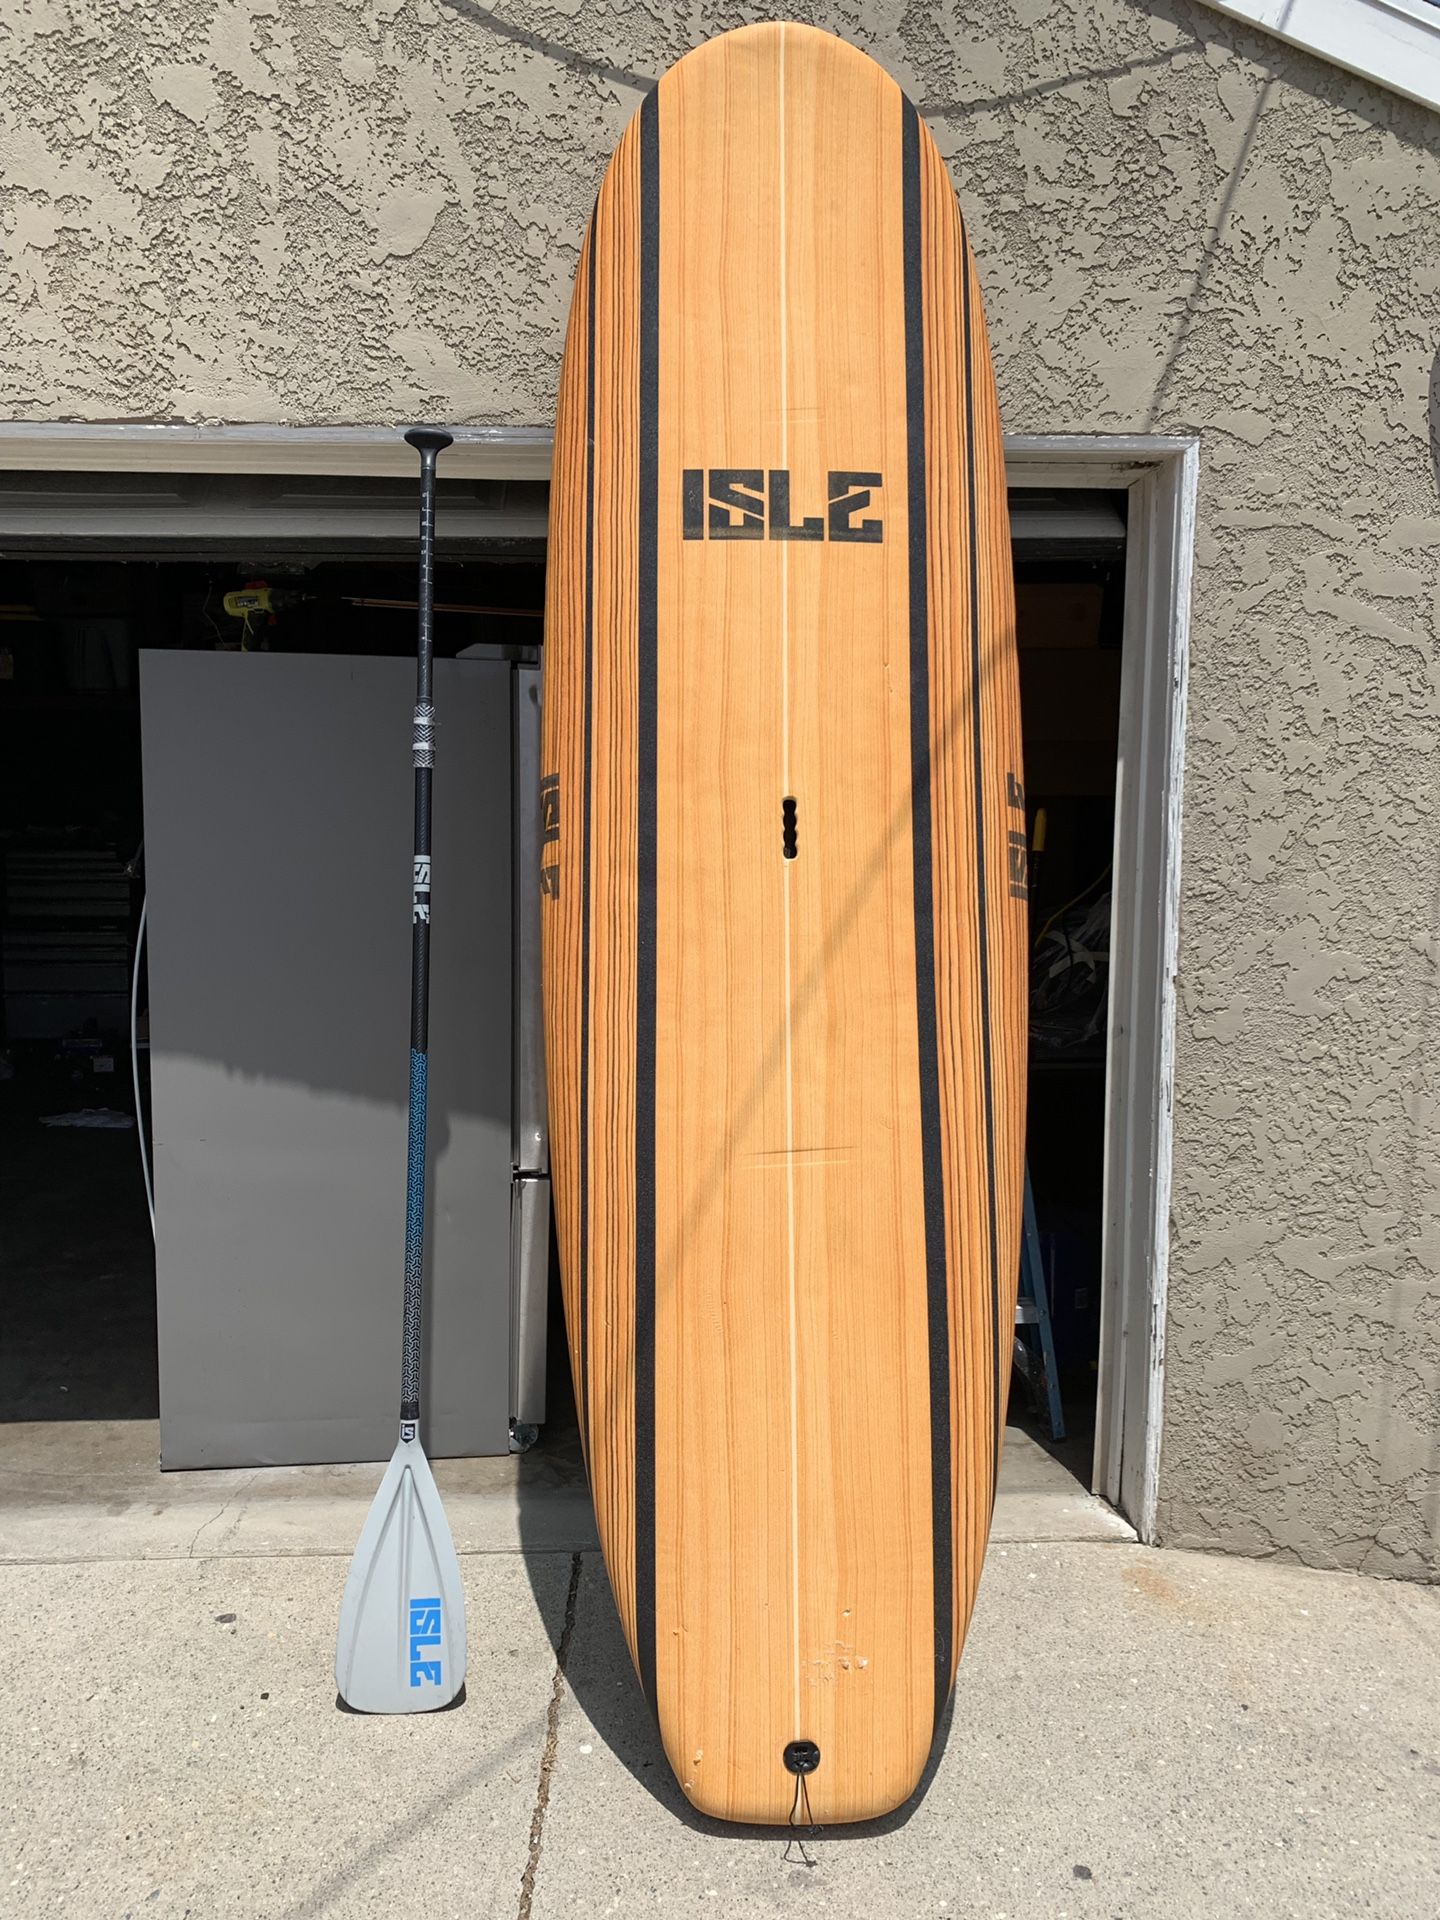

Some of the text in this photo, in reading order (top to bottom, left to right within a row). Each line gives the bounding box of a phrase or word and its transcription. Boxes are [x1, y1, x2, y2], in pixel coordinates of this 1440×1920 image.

[683, 469, 883, 543] ISLE
[413, 855, 431, 924] ISLE
[409, 1598, 441, 1687] ISLE
